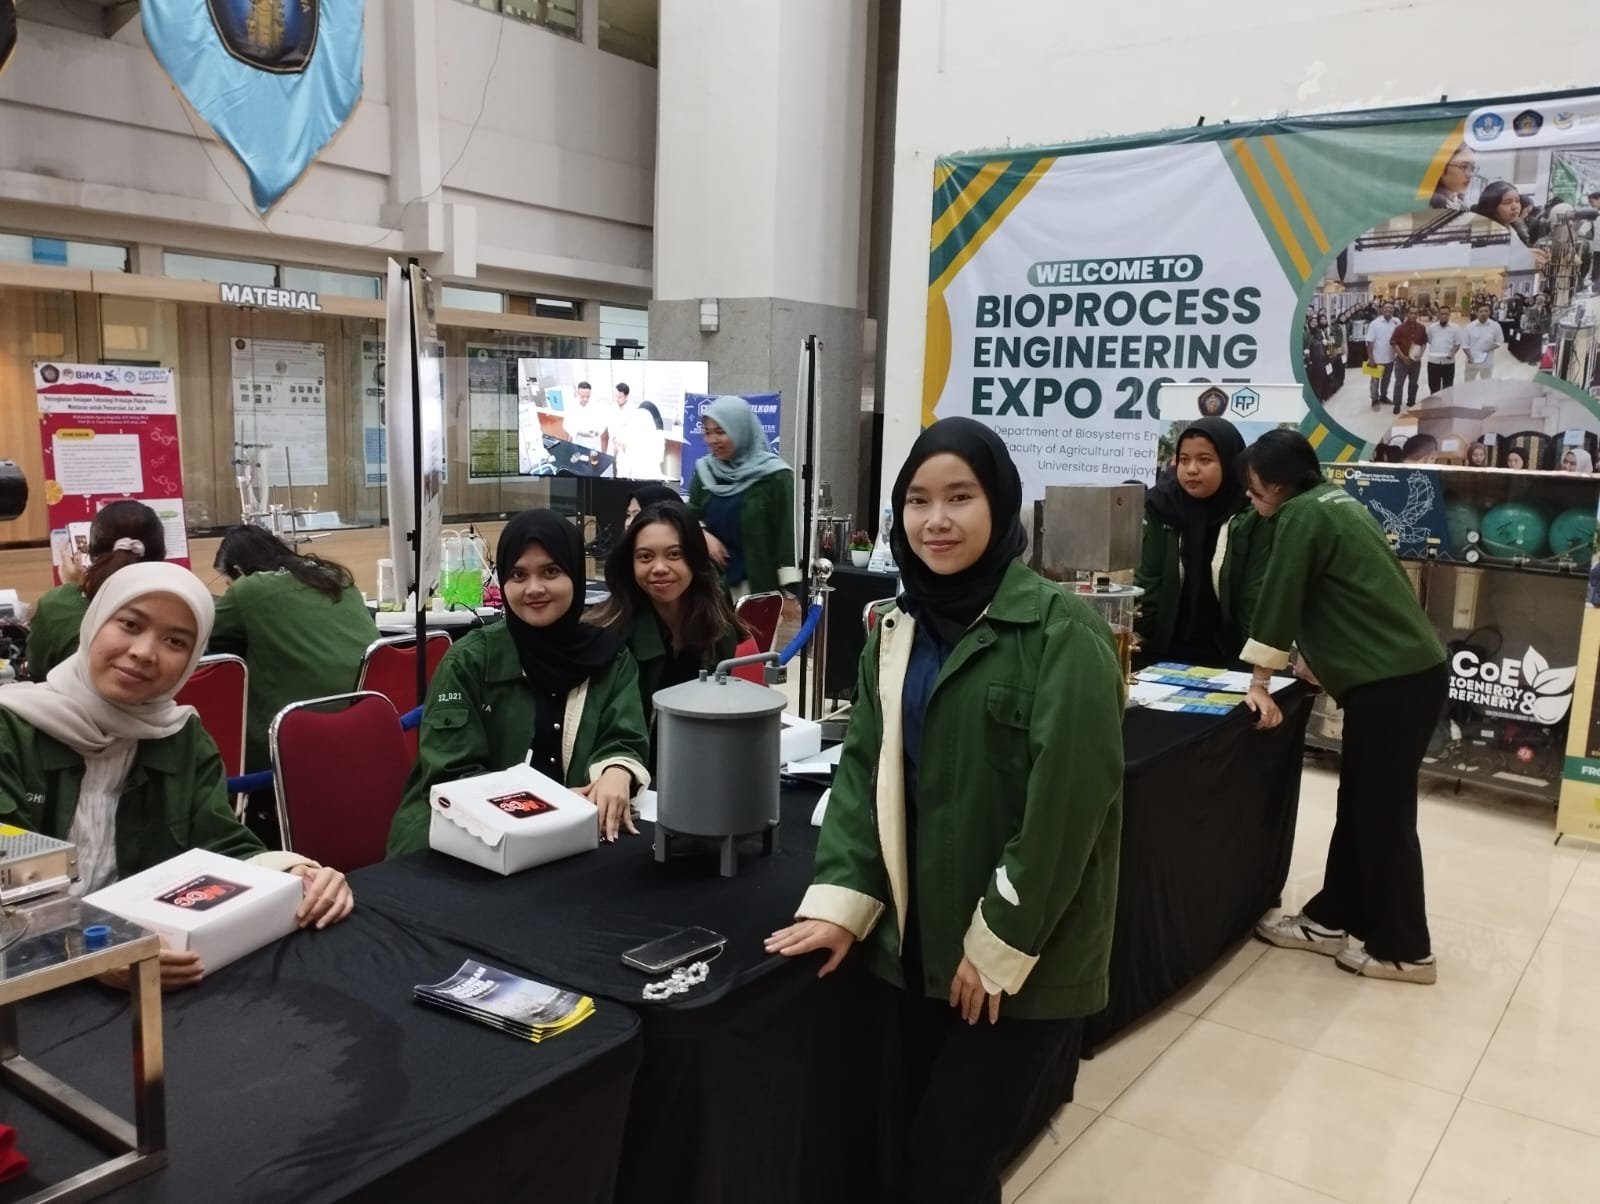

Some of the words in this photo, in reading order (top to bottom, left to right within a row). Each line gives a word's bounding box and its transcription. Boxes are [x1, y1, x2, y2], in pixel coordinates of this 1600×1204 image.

[1036, 259, 1154, 283] WELCOME
[1161, 257, 1194, 279] TO
[221, 284, 321, 311] MATERIAL
[975, 287, 1261, 329] BIOPROCESS
[973, 334, 1258, 369] ENGINEERING
[971, 376, 1103, 419] EXPO
[994, 425, 1058, 438] Department
[1062, 428, 1072, 438] of
[1075, 428, 1141, 442] Biosystems
[1045, 444, 1057, 454] of
[1059, 445, 1125, 459] Agricultural
[1038, 460, 1098, 473] Universitas
[1452, 650, 1521, 687] CoE
